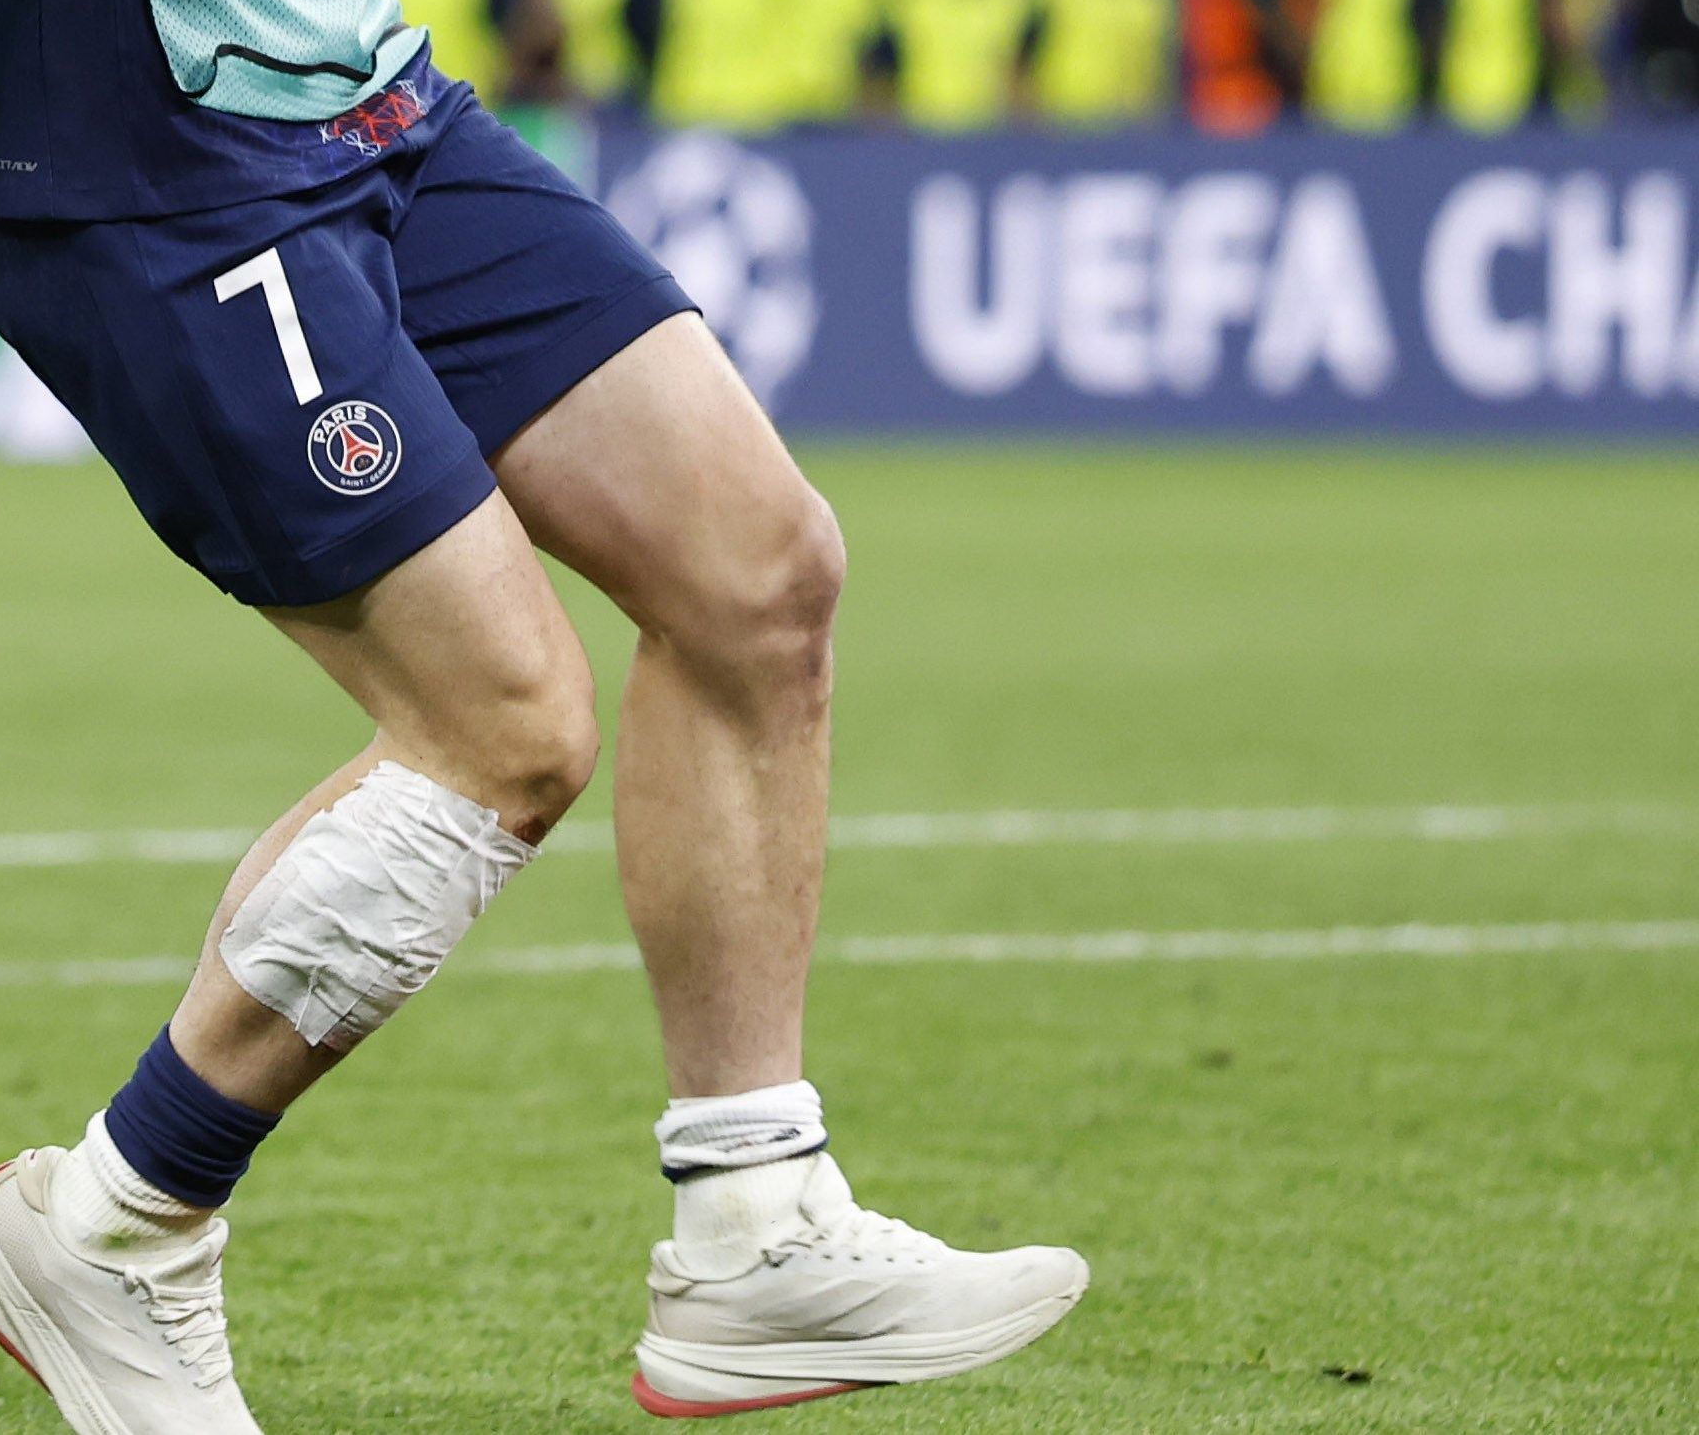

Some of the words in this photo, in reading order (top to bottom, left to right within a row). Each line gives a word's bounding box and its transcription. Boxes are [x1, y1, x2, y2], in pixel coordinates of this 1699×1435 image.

[213, 246, 324, 406] 7
[909, 173, 1393, 393] UEFA
[1421, 168, 1699, 398] CH
[313, 405, 367, 444] PARIS
